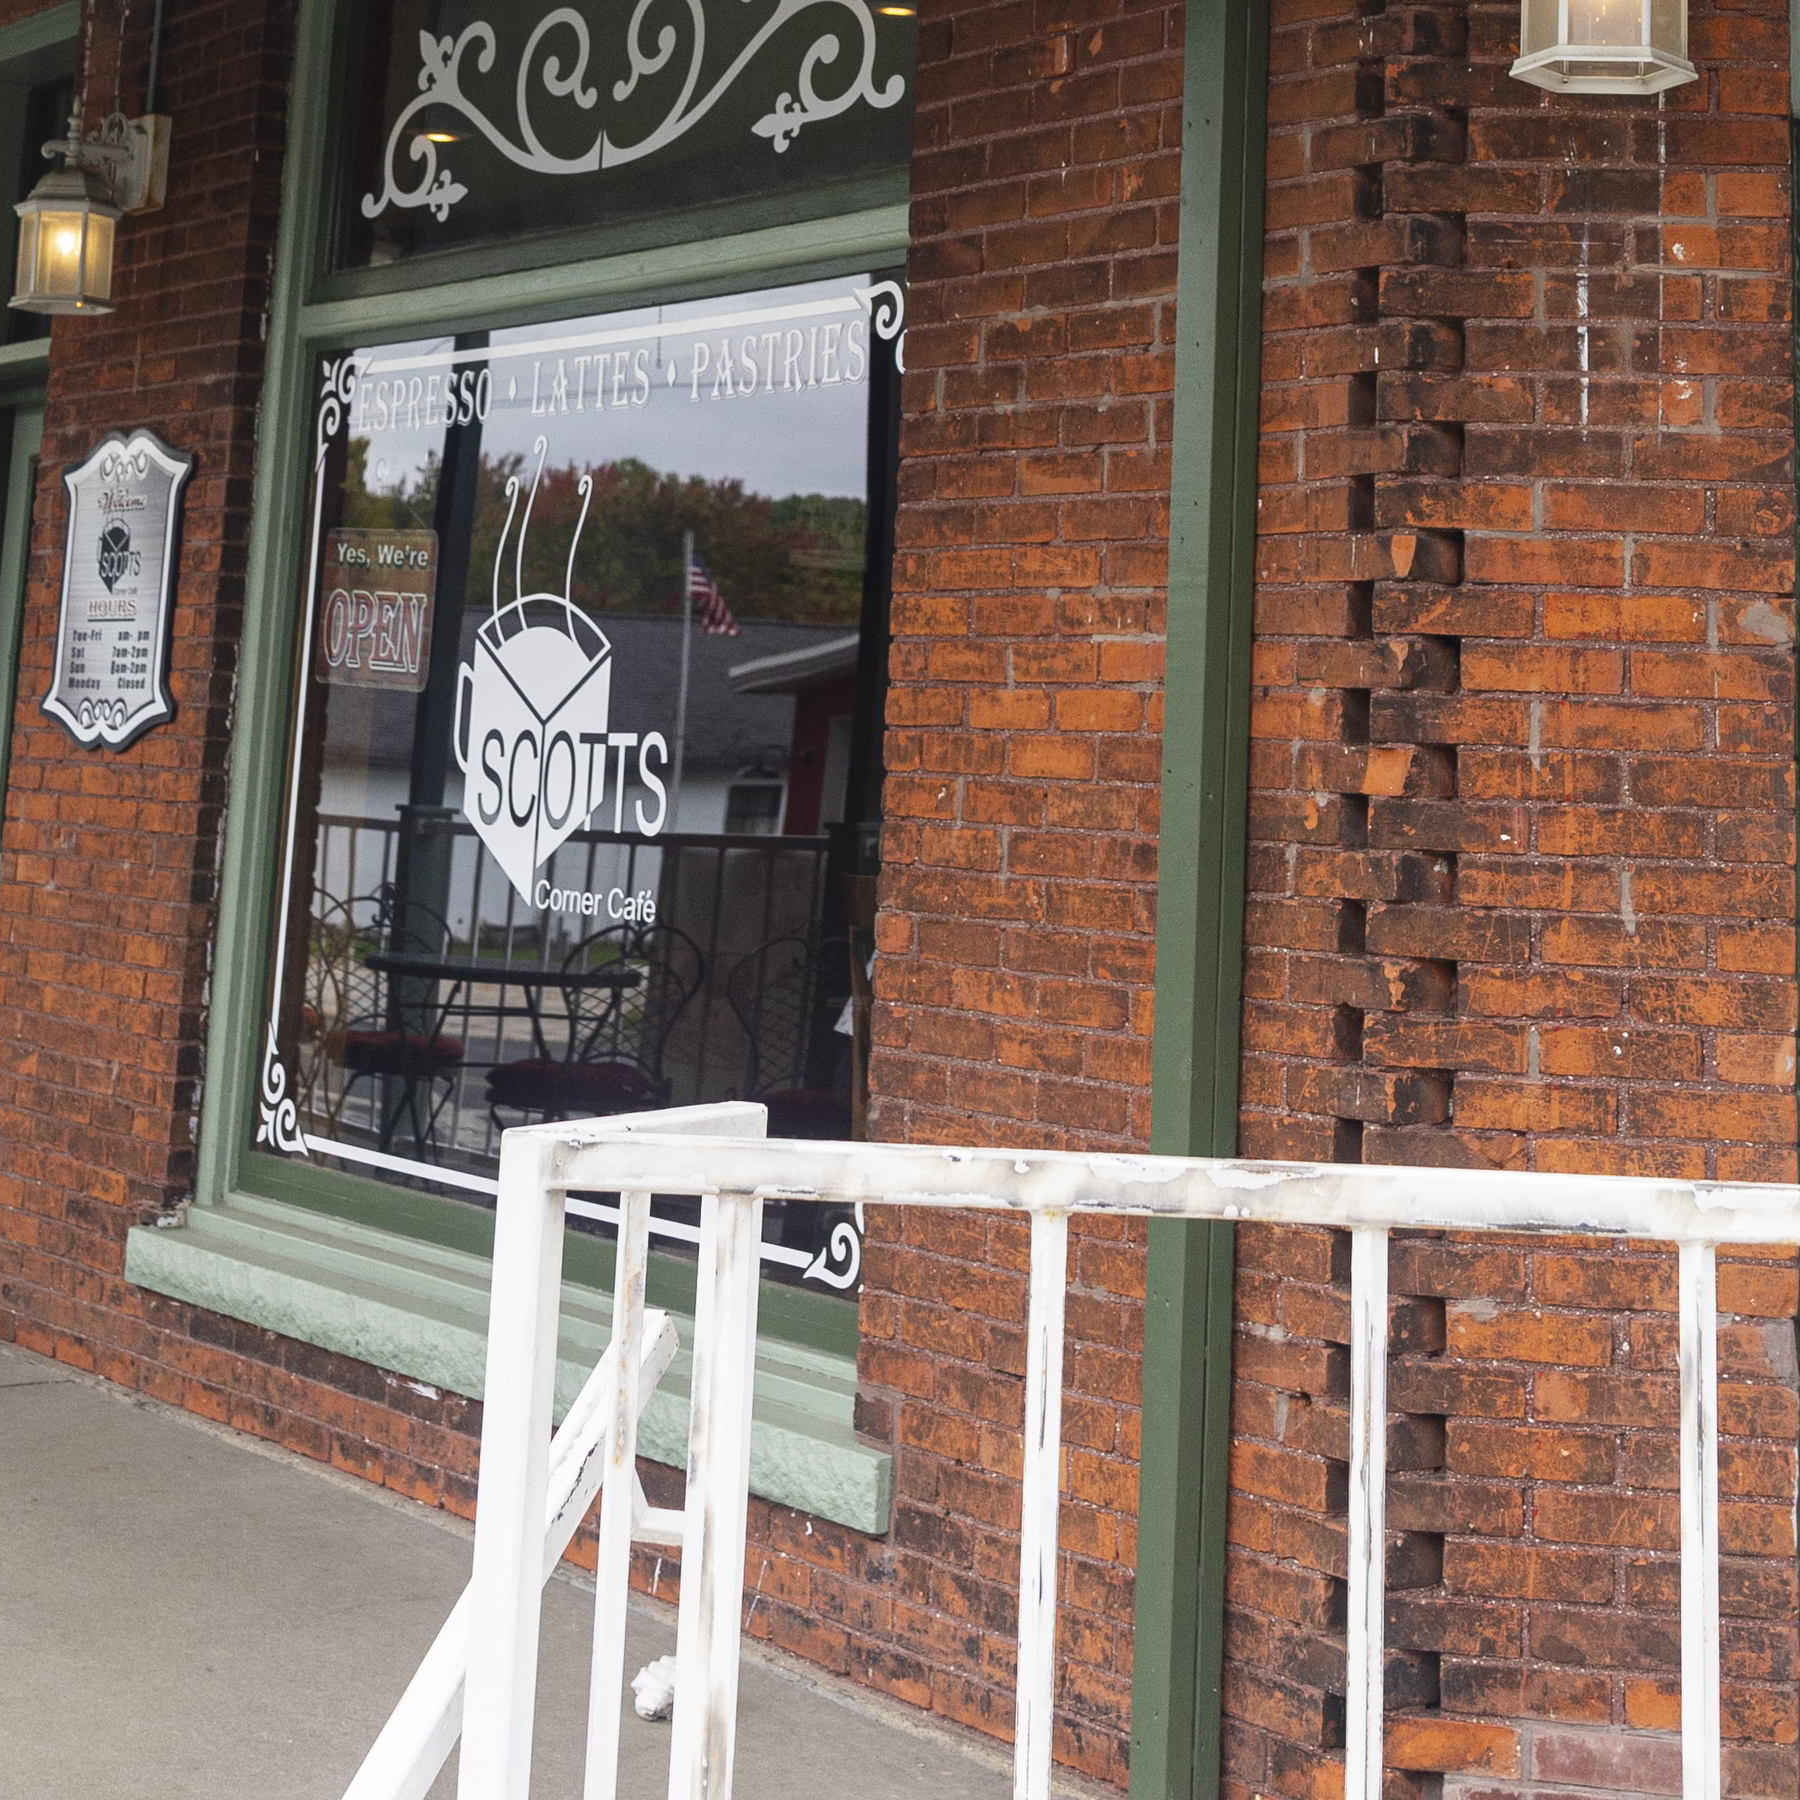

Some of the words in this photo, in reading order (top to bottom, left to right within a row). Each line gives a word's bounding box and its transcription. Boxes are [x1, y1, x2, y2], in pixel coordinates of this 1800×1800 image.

[356, 367, 493, 436] ESPRESSO
[530, 347, 653, 417] LATTES
[690, 318, 869, 403] PASTRIES
[337, 542, 371, 567] Yes,
[378, 544, 429, 567] We're
[88, 600, 136, 617] HOURS
[324, 588, 427, 673] OPEN
[477, 728, 669, 837] SCOTTS
[535, 879, 603, 916] Corner
[607, 887, 656, 923] Café
